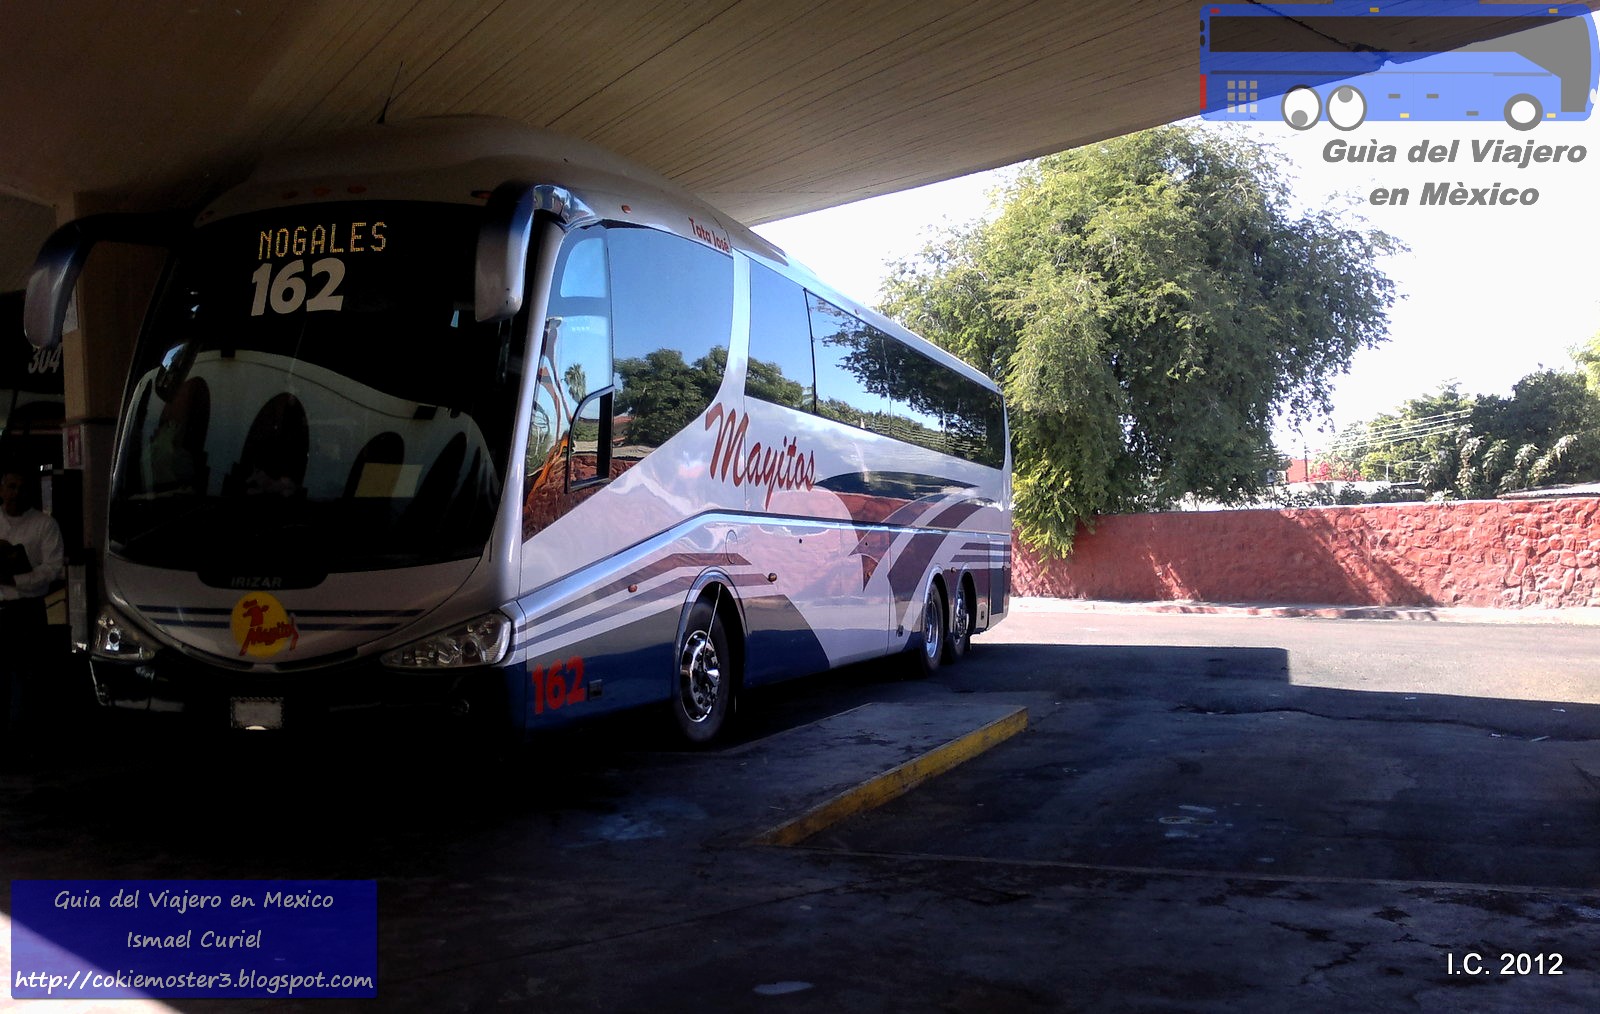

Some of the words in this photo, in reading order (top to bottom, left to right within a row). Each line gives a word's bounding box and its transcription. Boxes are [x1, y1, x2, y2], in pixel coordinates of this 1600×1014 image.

[257, 221, 388, 260] NOGALES
[688, 216, 712, 244] Tata
[711, 230, 730, 253] José
[250, 257, 345, 317] 162
[705, 402, 816, 512] Mayitos
[230, 576, 283, 588] IRIZAR
[533, 656, 585, 716] 162
